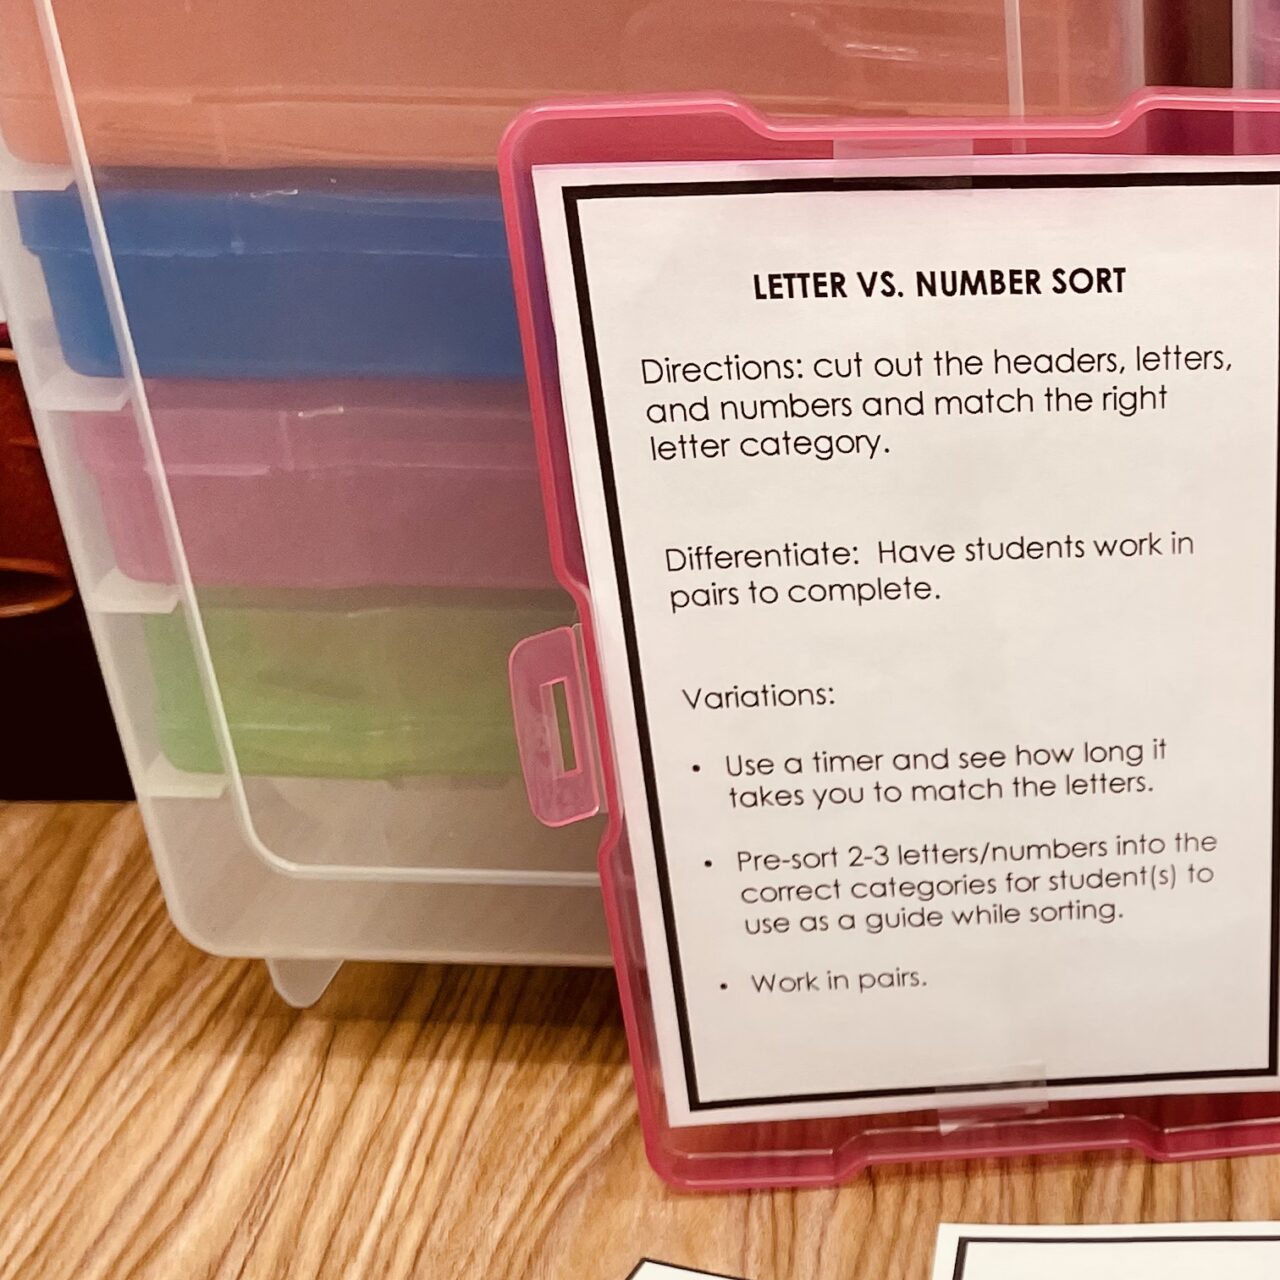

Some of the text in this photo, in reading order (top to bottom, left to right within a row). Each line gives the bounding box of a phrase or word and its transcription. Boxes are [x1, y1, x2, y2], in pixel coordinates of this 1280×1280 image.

[752, 266, 1127, 301] LETTER VS. NUMBER SORT
[640, 344, 1232, 385] Directions: cut out the headers, letters,
[645, 383, 1169, 425] and numbers and match the right
[649, 429, 891, 462] letter category.
[664, 530, 1195, 573] Differentiate: Have students work in
[669, 575, 941, 615] pairs to complete.
[681, 683, 836, 711] Variations:
[725, 737, 1167, 778] Use a timer and see how long it
[728, 772, 1154, 811] takes you to match the letters.
[736, 832, 1218, 873] Pre-sort 2-3 letters/numbers into the
[740, 863, 1215, 905] correct categories for student(s) to
[744, 898, 1124, 936] use as a guide while sorting.
[750, 966, 928, 994] Work in pairs.
